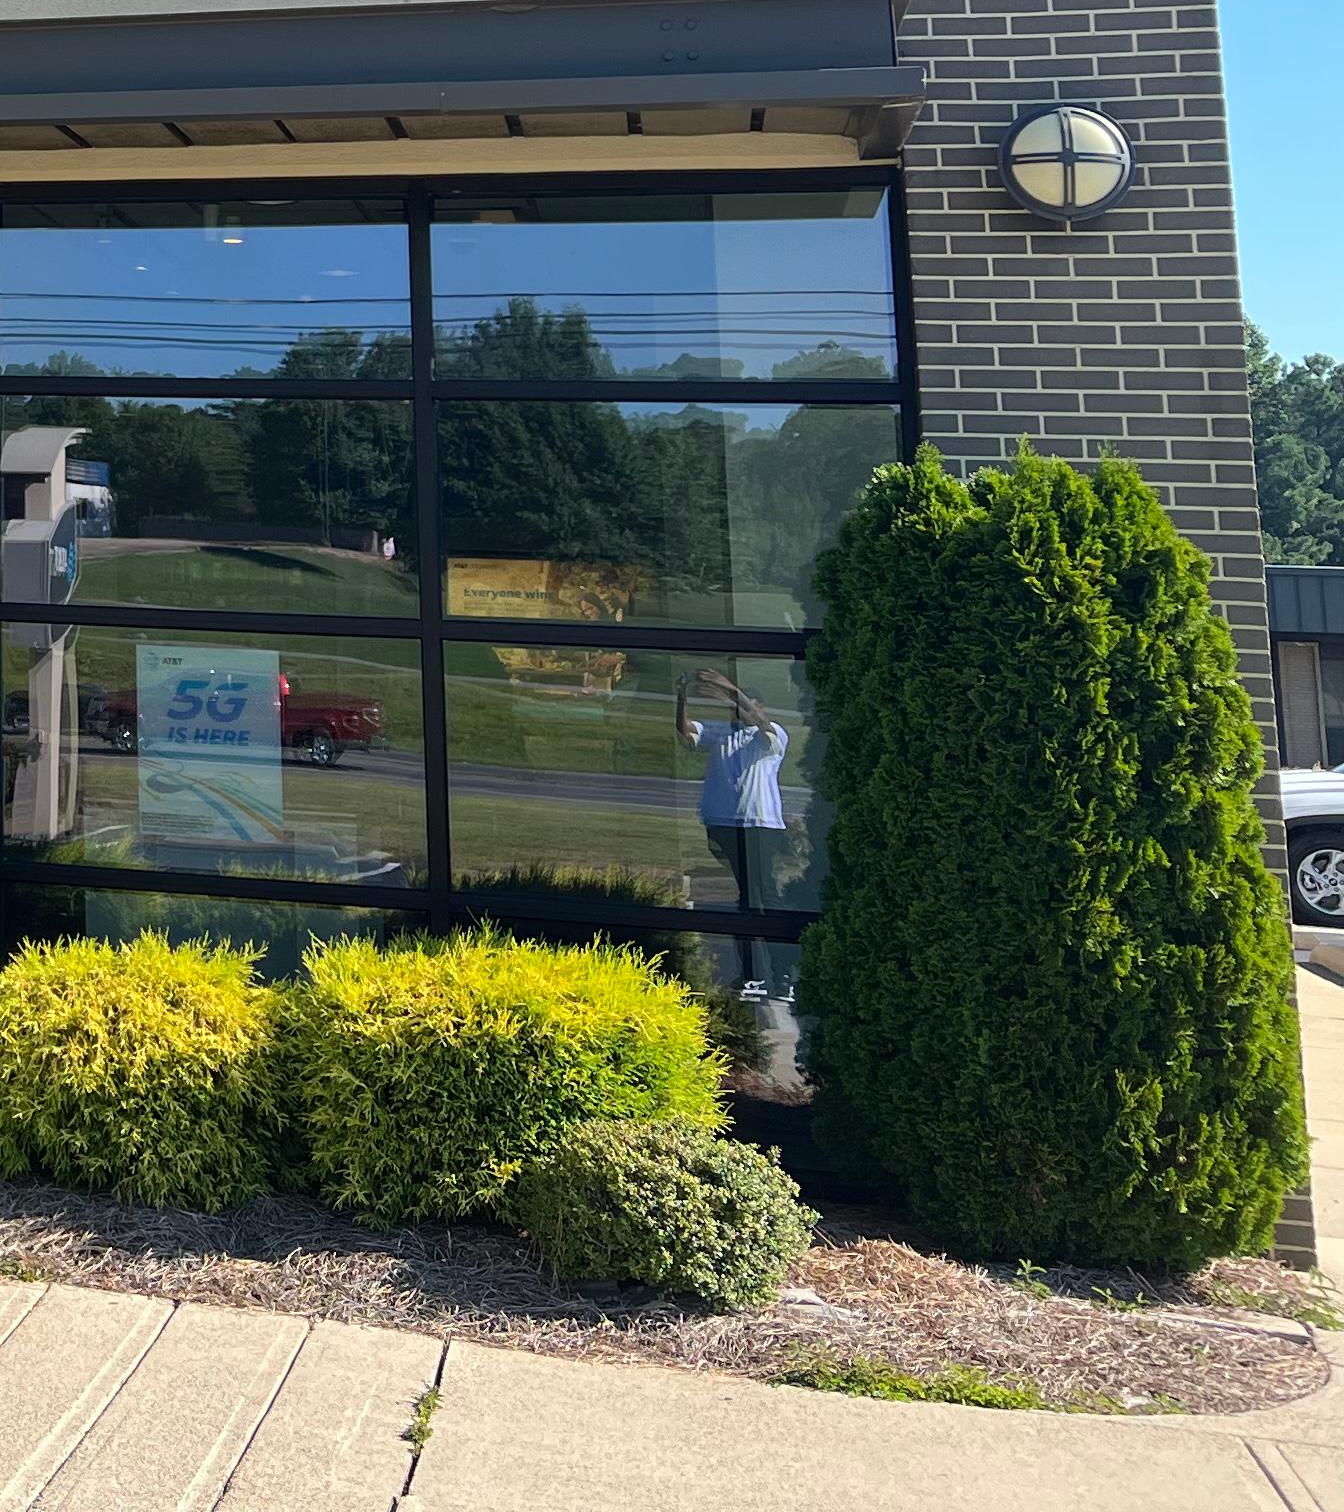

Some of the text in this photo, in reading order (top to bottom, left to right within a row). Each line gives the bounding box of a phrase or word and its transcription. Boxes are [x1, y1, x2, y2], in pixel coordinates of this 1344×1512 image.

[463, 588, 522, 600] Everyone
[162, 656, 184, 666] AT&T
[166, 679, 250, 723] 5G
[167, 726, 251, 747] IS HERE
